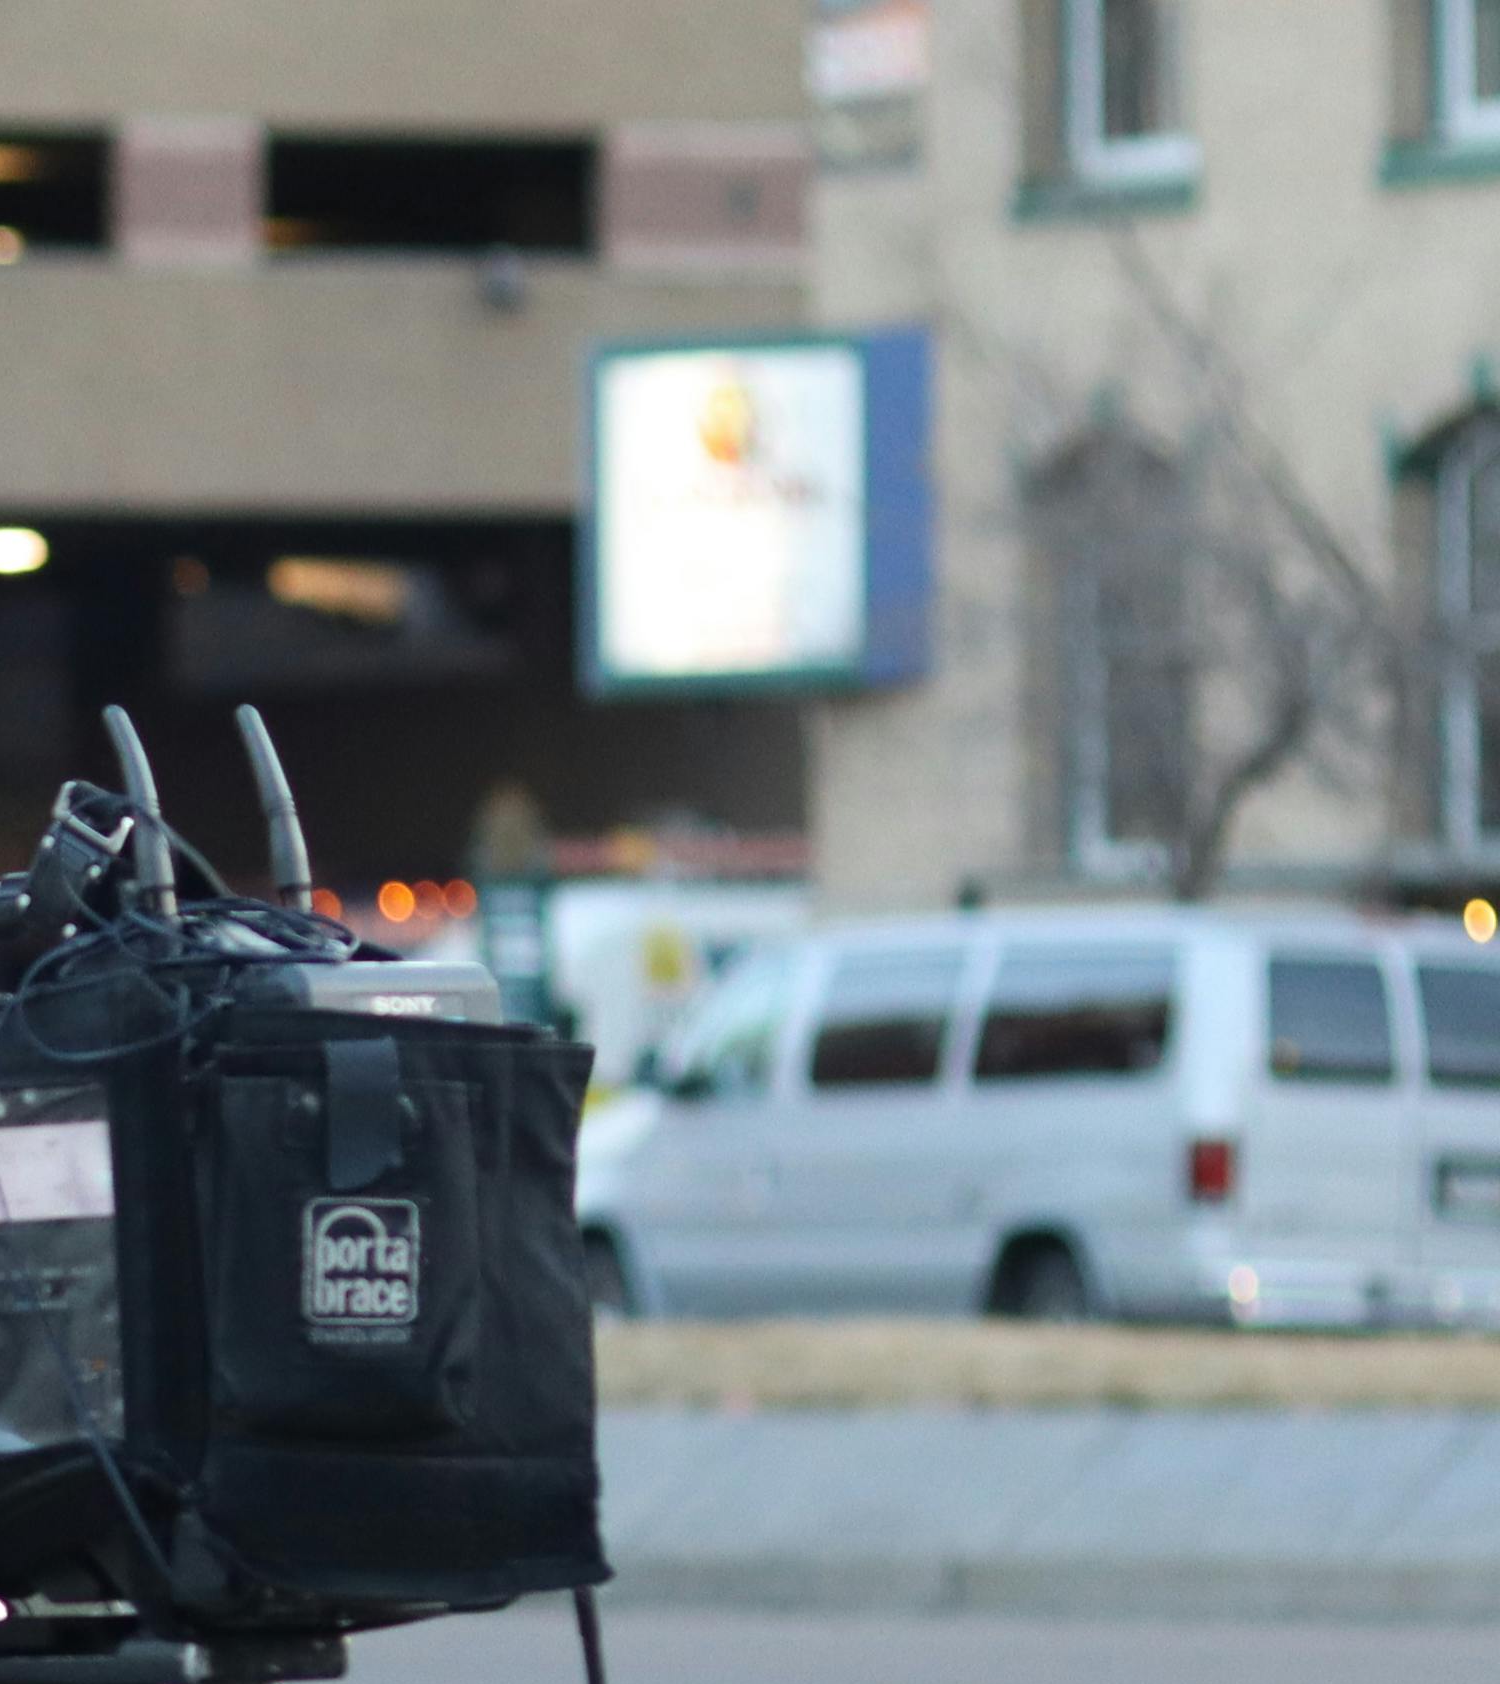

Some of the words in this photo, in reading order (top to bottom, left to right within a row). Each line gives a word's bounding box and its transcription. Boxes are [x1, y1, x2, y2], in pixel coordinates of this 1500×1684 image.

[372, 995, 437, 1016] SONY
[315, 1235, 410, 1273] porta
[314, 1277, 410, 1316] brace
